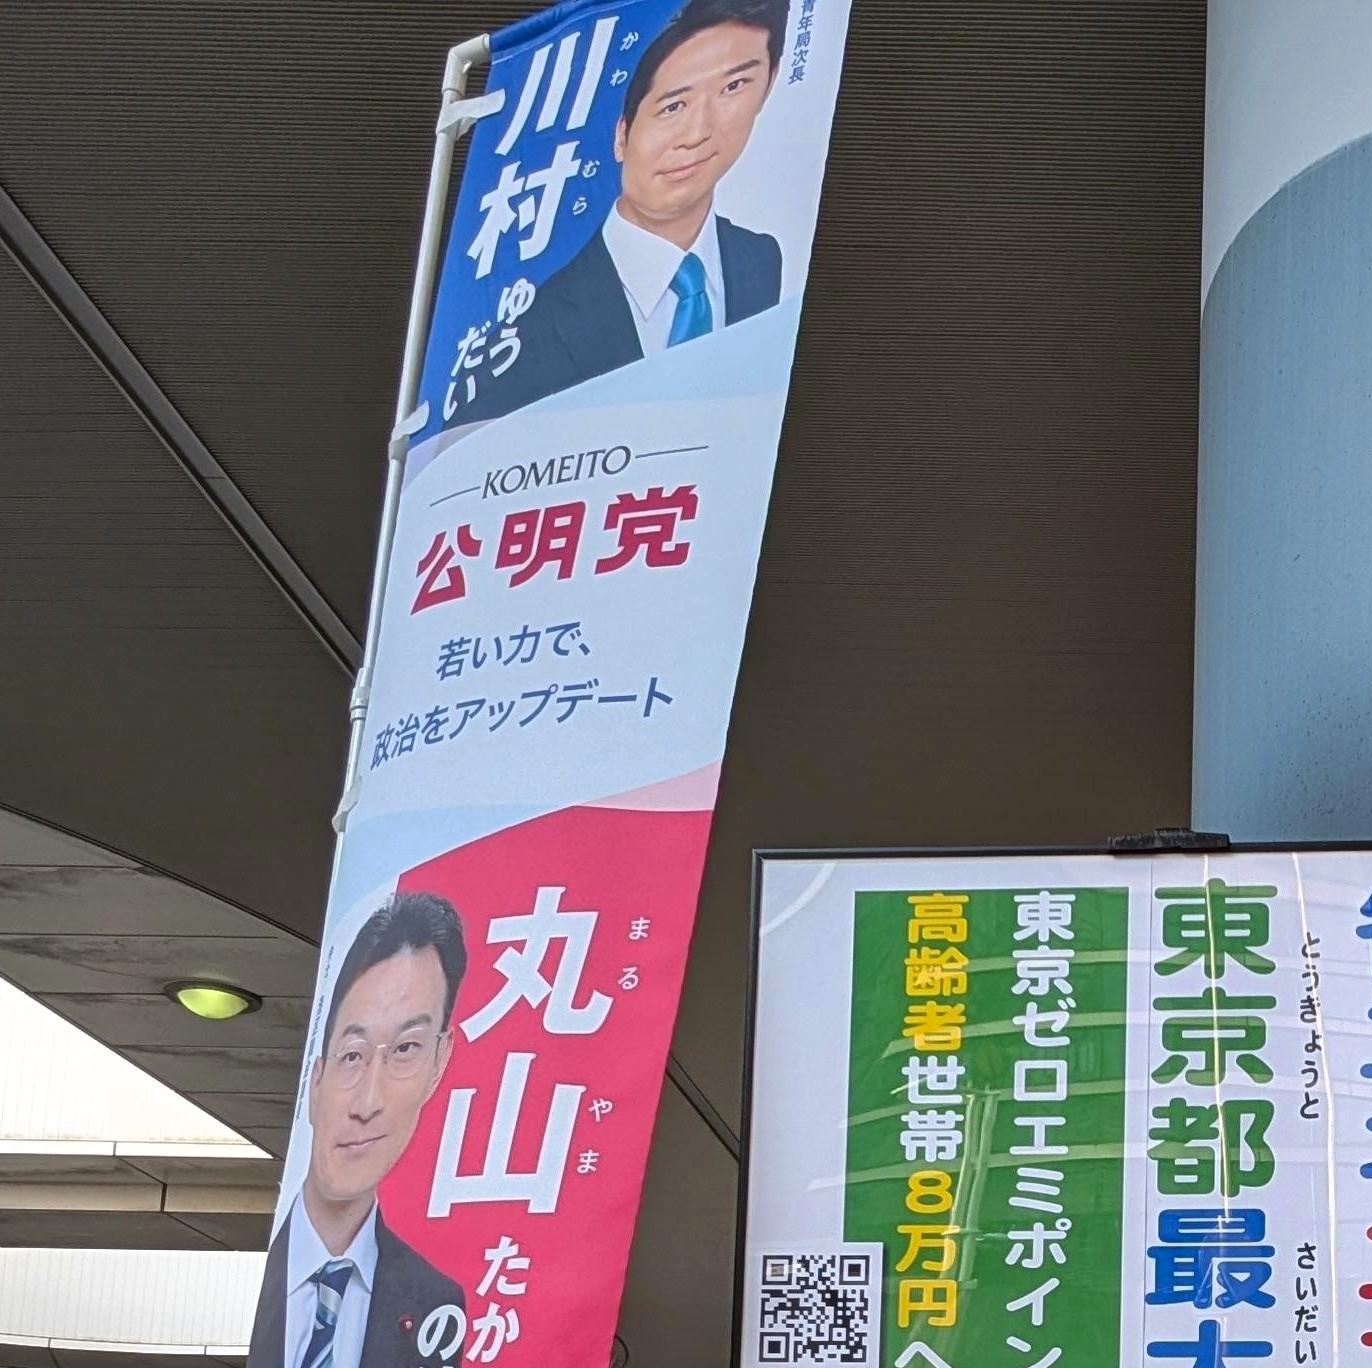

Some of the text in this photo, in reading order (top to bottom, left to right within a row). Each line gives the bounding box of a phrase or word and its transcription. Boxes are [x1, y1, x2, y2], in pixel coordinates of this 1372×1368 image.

[610, 31, 640, 87] かわ
[467, 16, 619, 280] 川村
[573, 160, 600, 215] むら
[482, 445, 632, 498] KOMEITO
[411, 484, 699, 615] 公明党
[436, 622, 591, 681] 若い力で、
[371, 677, 673, 771] 政治をアップデート
[617, 916, 651, 991] まる
[425, 886, 614, 1219] 丸山
[1300, 931, 1323, 1120] とうきょうと
[576, 1098, 613, 1174] やま
[1294, 1242, 1320, 1365] さいだい
